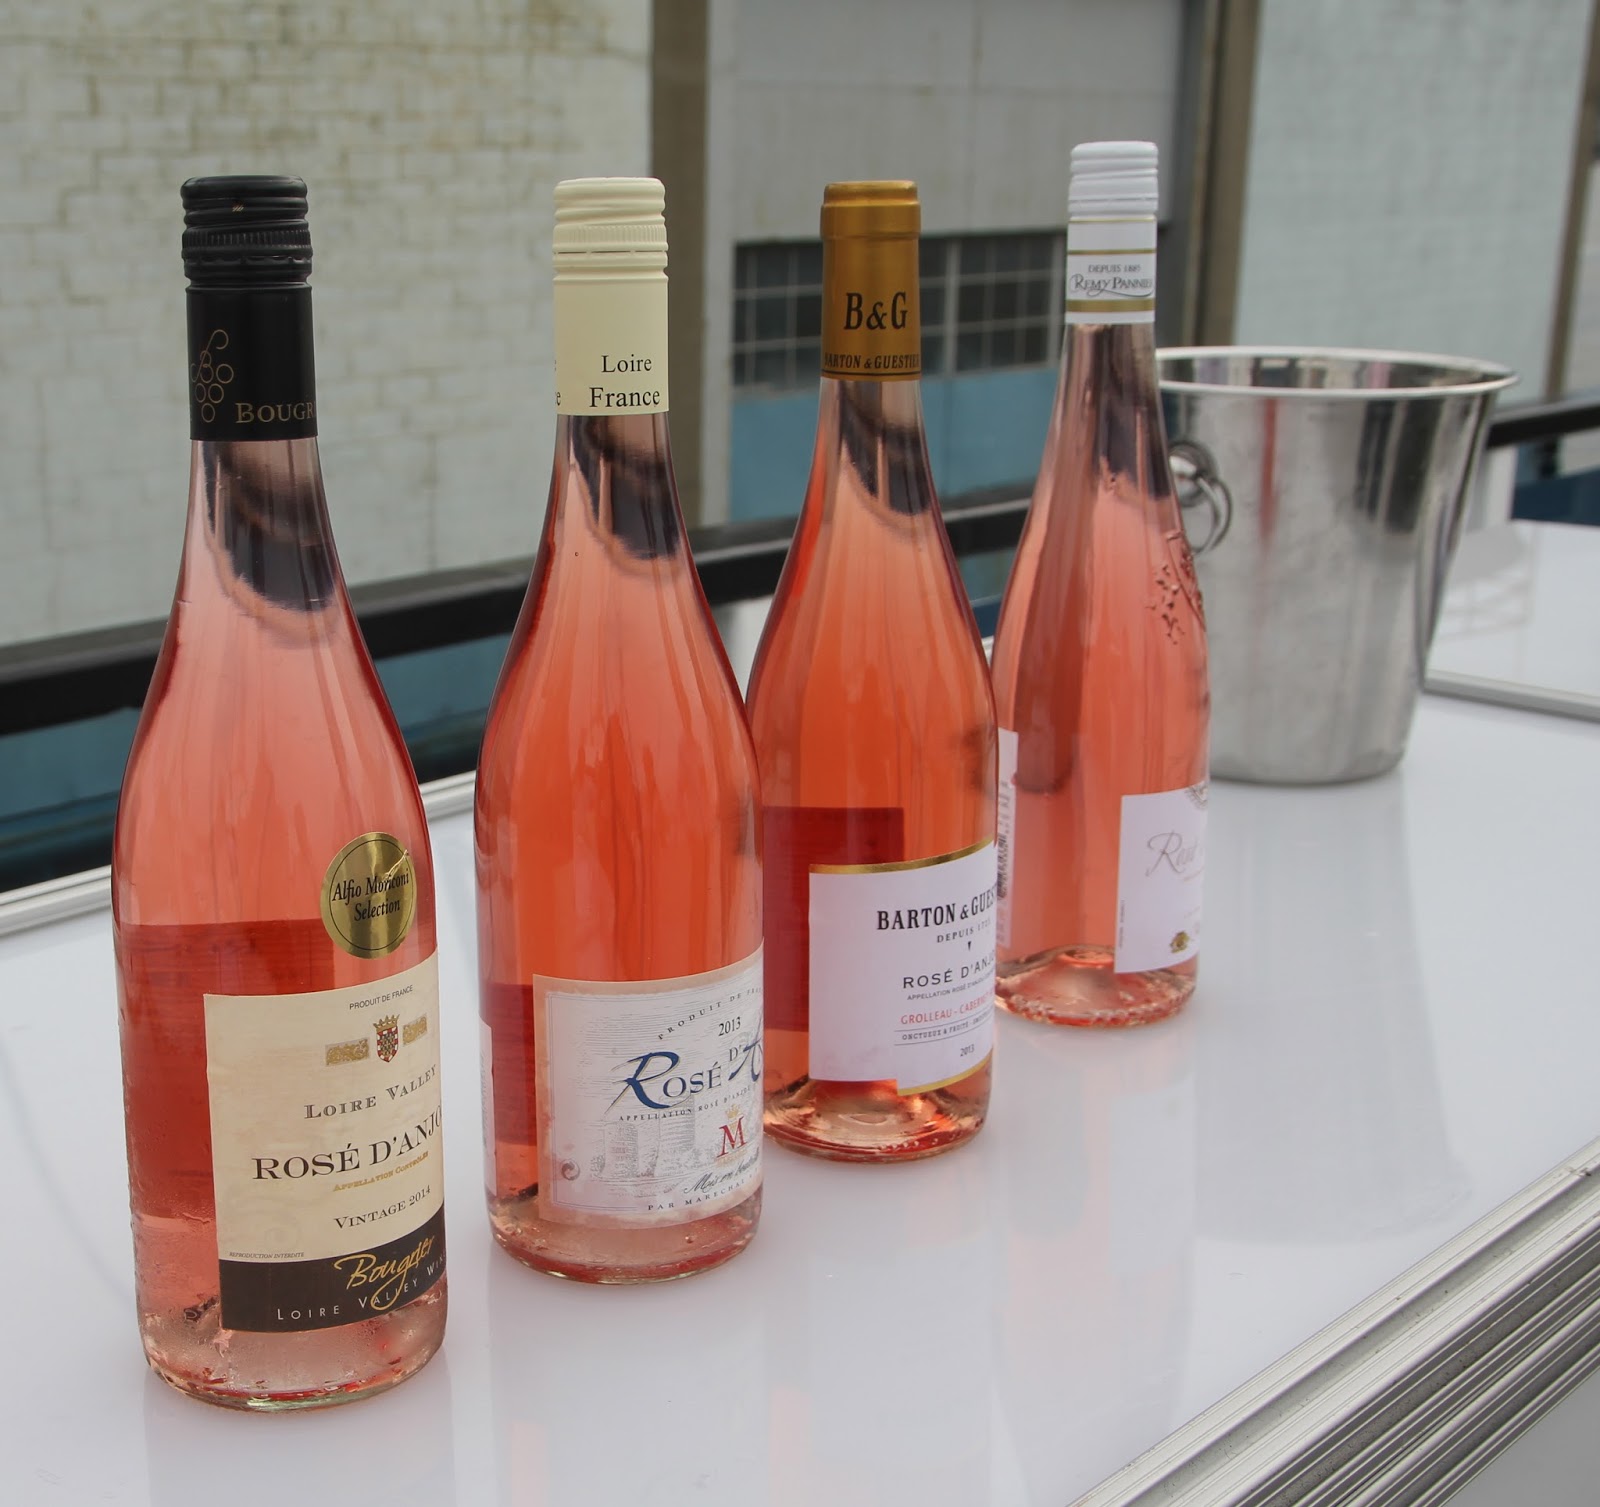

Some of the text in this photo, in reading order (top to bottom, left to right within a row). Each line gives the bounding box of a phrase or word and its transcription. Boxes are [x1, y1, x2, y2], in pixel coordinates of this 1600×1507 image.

[1088, 263, 1121, 273] DEPUIS
[843, 291, 908, 330] B&G
[601, 353, 652, 373] Loire
[863, 358, 873, 369] &
[588, 387, 661, 408] France
[331, 867, 410, 906] Alfio Moriconi
[353, 897, 401, 921] Selection
[876, 884, 997, 931] BARTON & GUES
[936, 926, 974, 943] DEPUIS
[903, 967, 953, 989] ROSÉ
[349, 985, 414, 1011] PRODUIT DE FRANCE
[906, 988, 951, 1001] APPELLATION
[658, 1001, 722, 1040] PRODUIT
[718, 1016, 742, 1037] 2013
[900, 1008, 953, 1025] GROLLEAU
[960, 1043, 975, 1057] 2013
[303, 1063, 438, 1120] LOIRE VALLEY
[604, 1051, 722, 1115] ROSÉ
[618, 1108, 693, 1122] APPELLATION
[715, 1116, 749, 1159] M
[251, 1142, 361, 1180] ROSÉ
[333, 1170, 394, 1192] APPELLATION
[647, 1178, 746, 1212] PAR MARECHAL
[333, 1184, 431, 1230] VINTAGE 2014
[229, 1251, 305, 1259] REPRODUCTION INTERDITE
[276, 1248, 446, 1321] LOIRE VALLEY WIN
